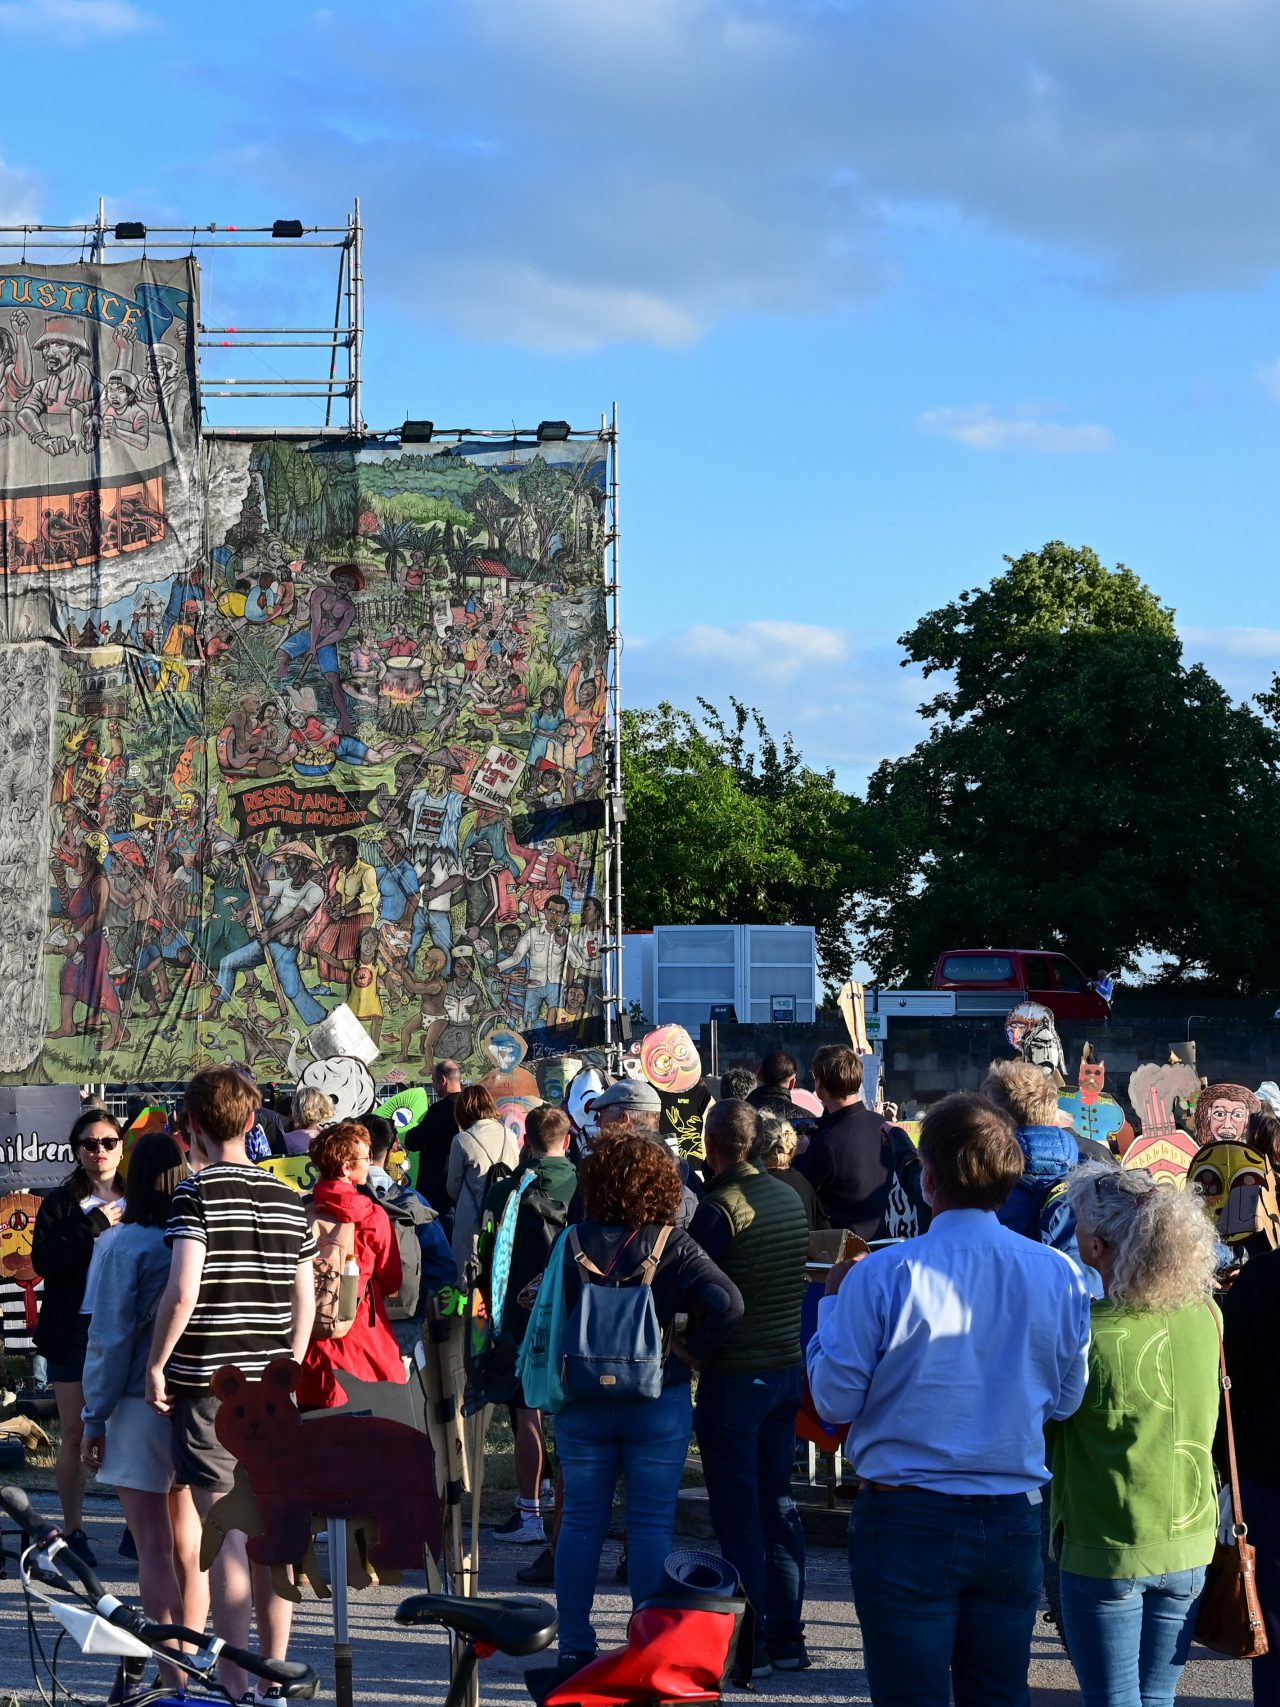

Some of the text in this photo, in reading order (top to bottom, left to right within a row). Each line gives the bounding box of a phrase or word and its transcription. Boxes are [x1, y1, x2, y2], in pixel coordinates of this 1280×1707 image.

[495, 752, 518, 770] NO
[242, 786, 347, 812] RESISTANCE
[246, 807, 368, 827] CULTURE MOVEMENT
